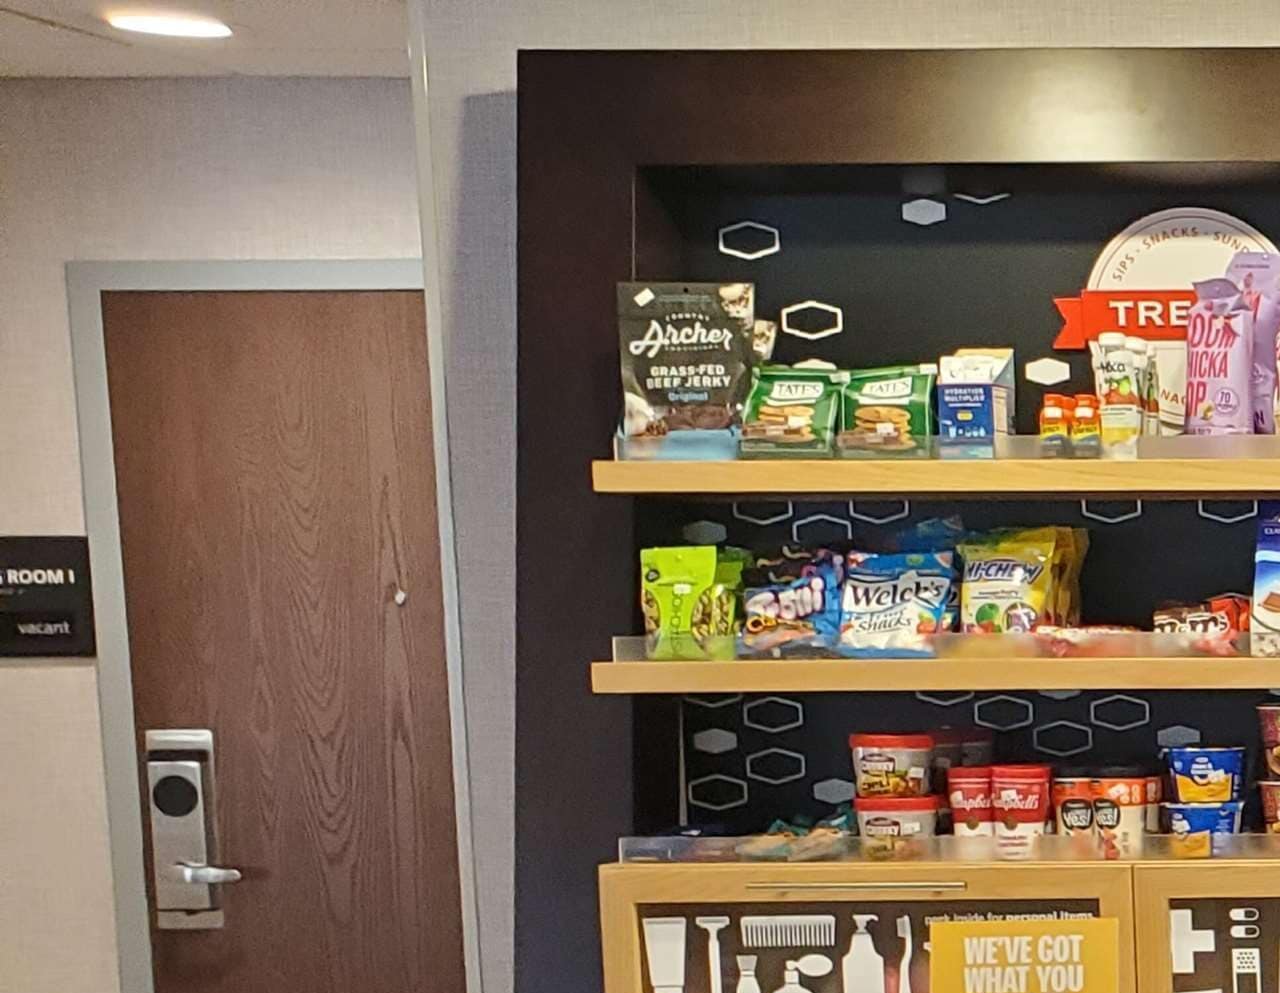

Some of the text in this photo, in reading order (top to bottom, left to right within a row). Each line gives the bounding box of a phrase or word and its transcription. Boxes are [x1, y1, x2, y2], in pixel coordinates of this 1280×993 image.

[1112, 253, 1135, 282] SIPS
[1142, 227, 1200, 249] SNACKS
[629, 319, 734, 358] Archer
[650, 364, 725, 377] GRASS-FED
[646, 375, 732, 390] BEEF JERKY
[7, 568, 65, 585] ROOM
[17, 620, 71, 635] vacant
[963, 935, 1084, 965] WE'VE GOT
[1035, 964, 1084, 993] YOU
